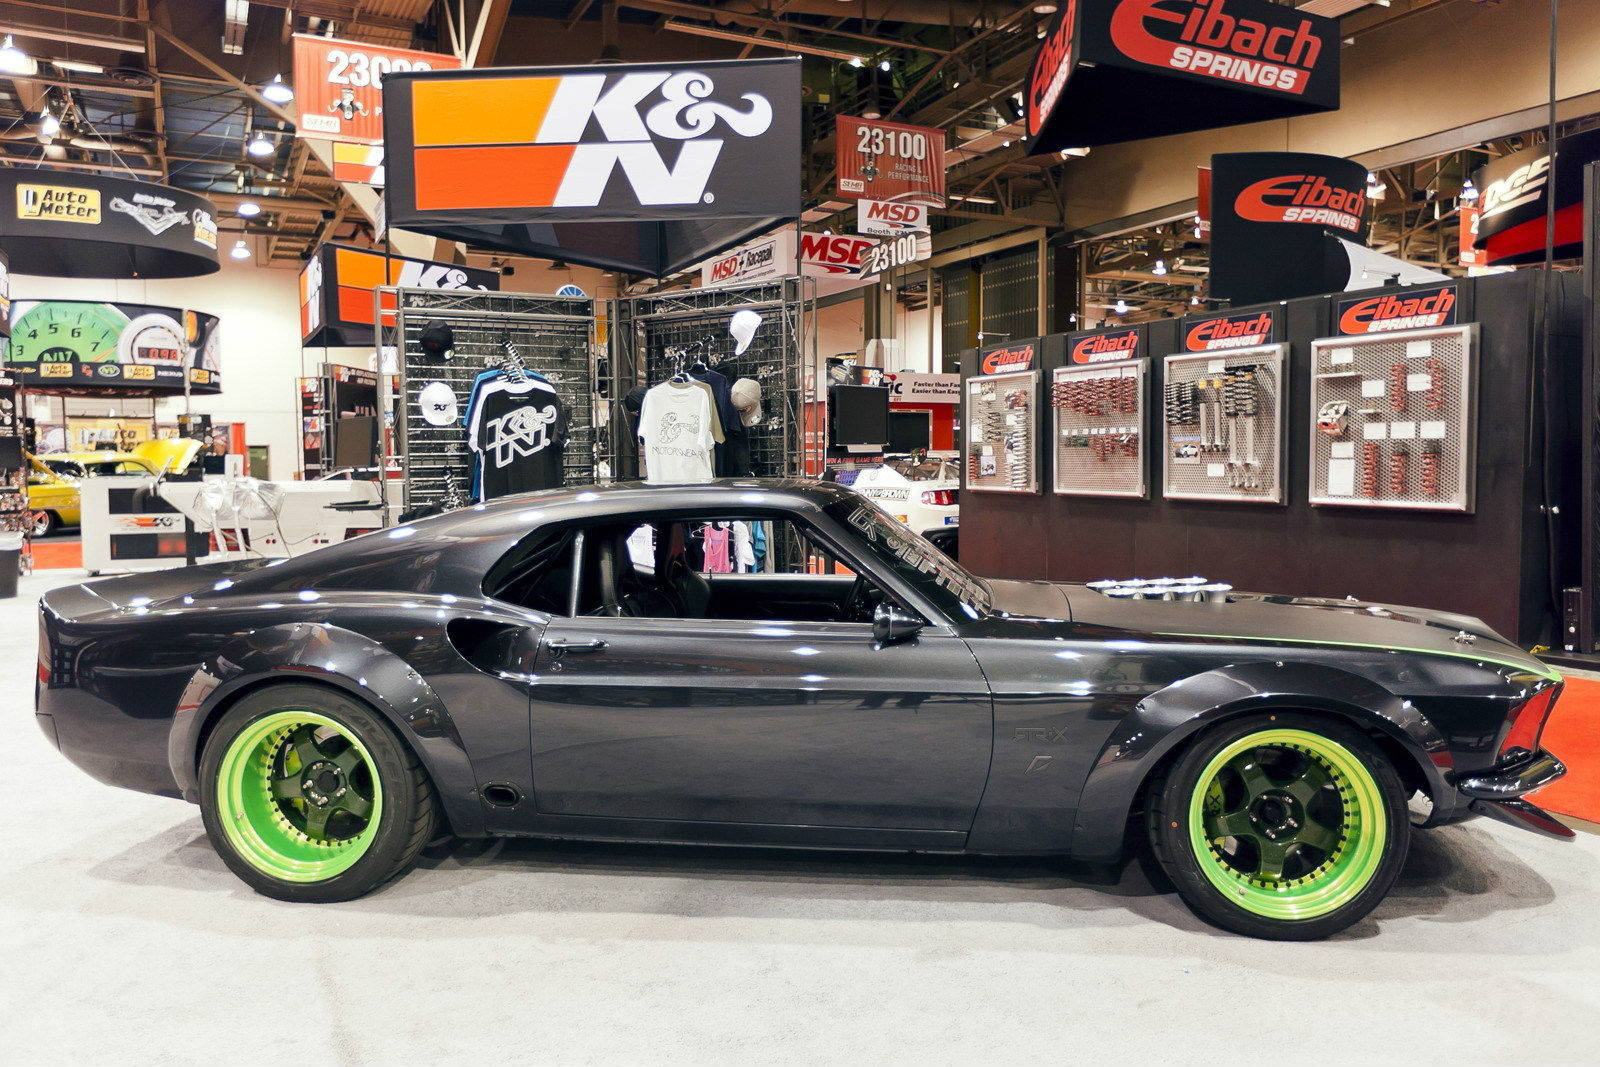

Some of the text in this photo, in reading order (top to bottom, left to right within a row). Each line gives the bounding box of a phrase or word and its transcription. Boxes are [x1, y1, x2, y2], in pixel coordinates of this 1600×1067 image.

[1110, 0, 1322, 69] Eibach
[1170, 46, 1299, 90] SPRINGS
[857, 126, 926, 160] 23100
[43, 190, 87, 204] Auto
[1234, 175, 1365, 219] Eibach
[38, 202, 97, 217] Meter
[867, 202, 920, 222] MSD
[1282, 208, 1359, 231] SPRINGS
[871, 235, 917, 273] 23100
[712, 257, 738, 281] MSD
[1339, 289, 1456, 333] Eibach
[28, 329, 38, 340] 4
[49, 323, 59, 334] 5
[71, 328, 82, 338] 6
[1186, 313, 1273, 350] Eibach
[1366, 313, 1440, 333] SPRINGS
[16, 345, 24, 356] 3
[91, 342, 100, 352] 7
[1073, 331, 1139, 363] Eibach
[982, 345, 1034, 373] Eibach
